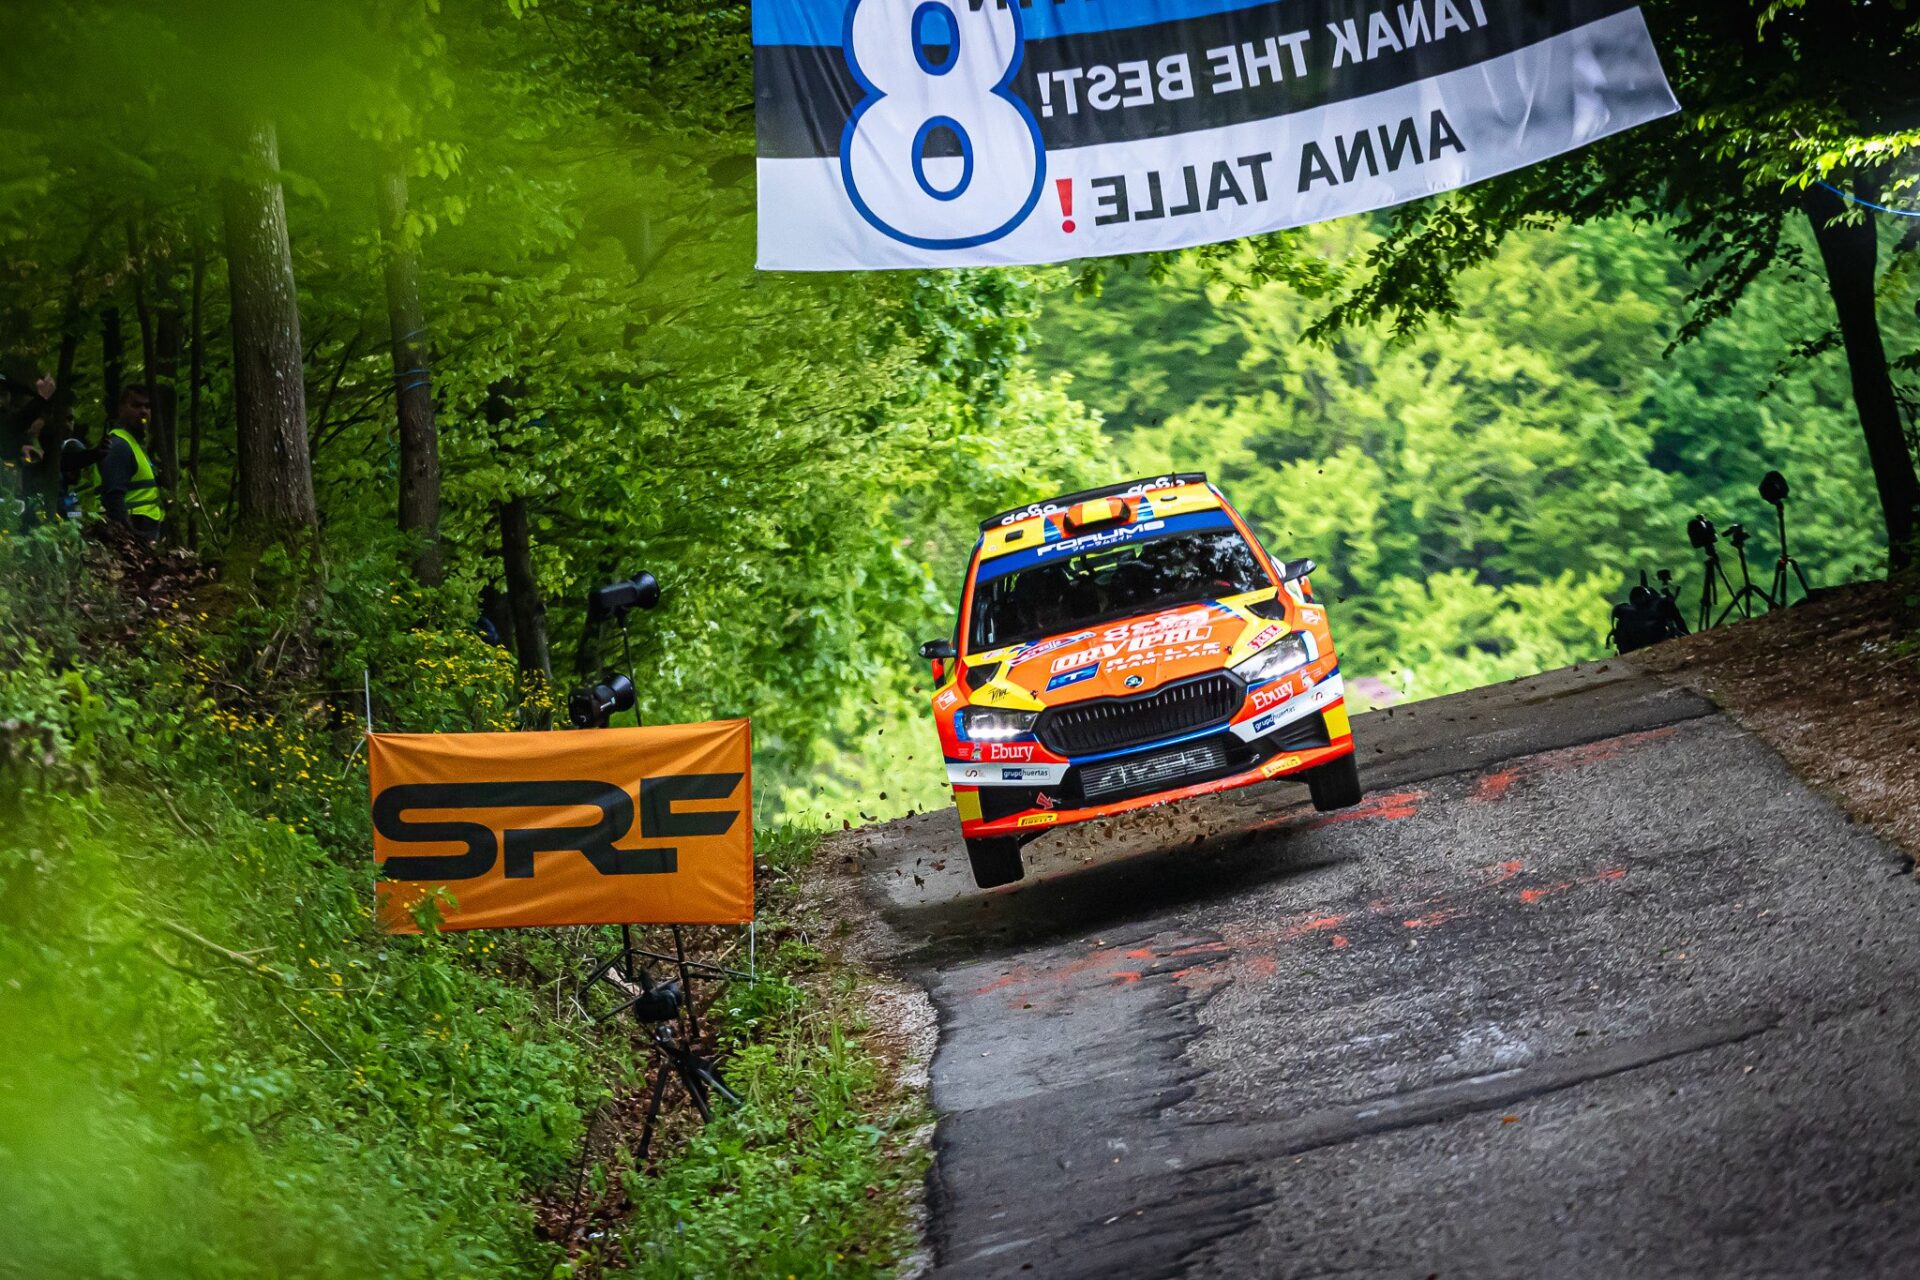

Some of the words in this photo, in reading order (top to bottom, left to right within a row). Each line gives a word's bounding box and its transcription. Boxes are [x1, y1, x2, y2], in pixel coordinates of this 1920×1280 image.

[1251, 681, 1294, 711] Ebury
[990, 743, 1034, 762] Ebury
[372, 772, 745, 882] SRF
